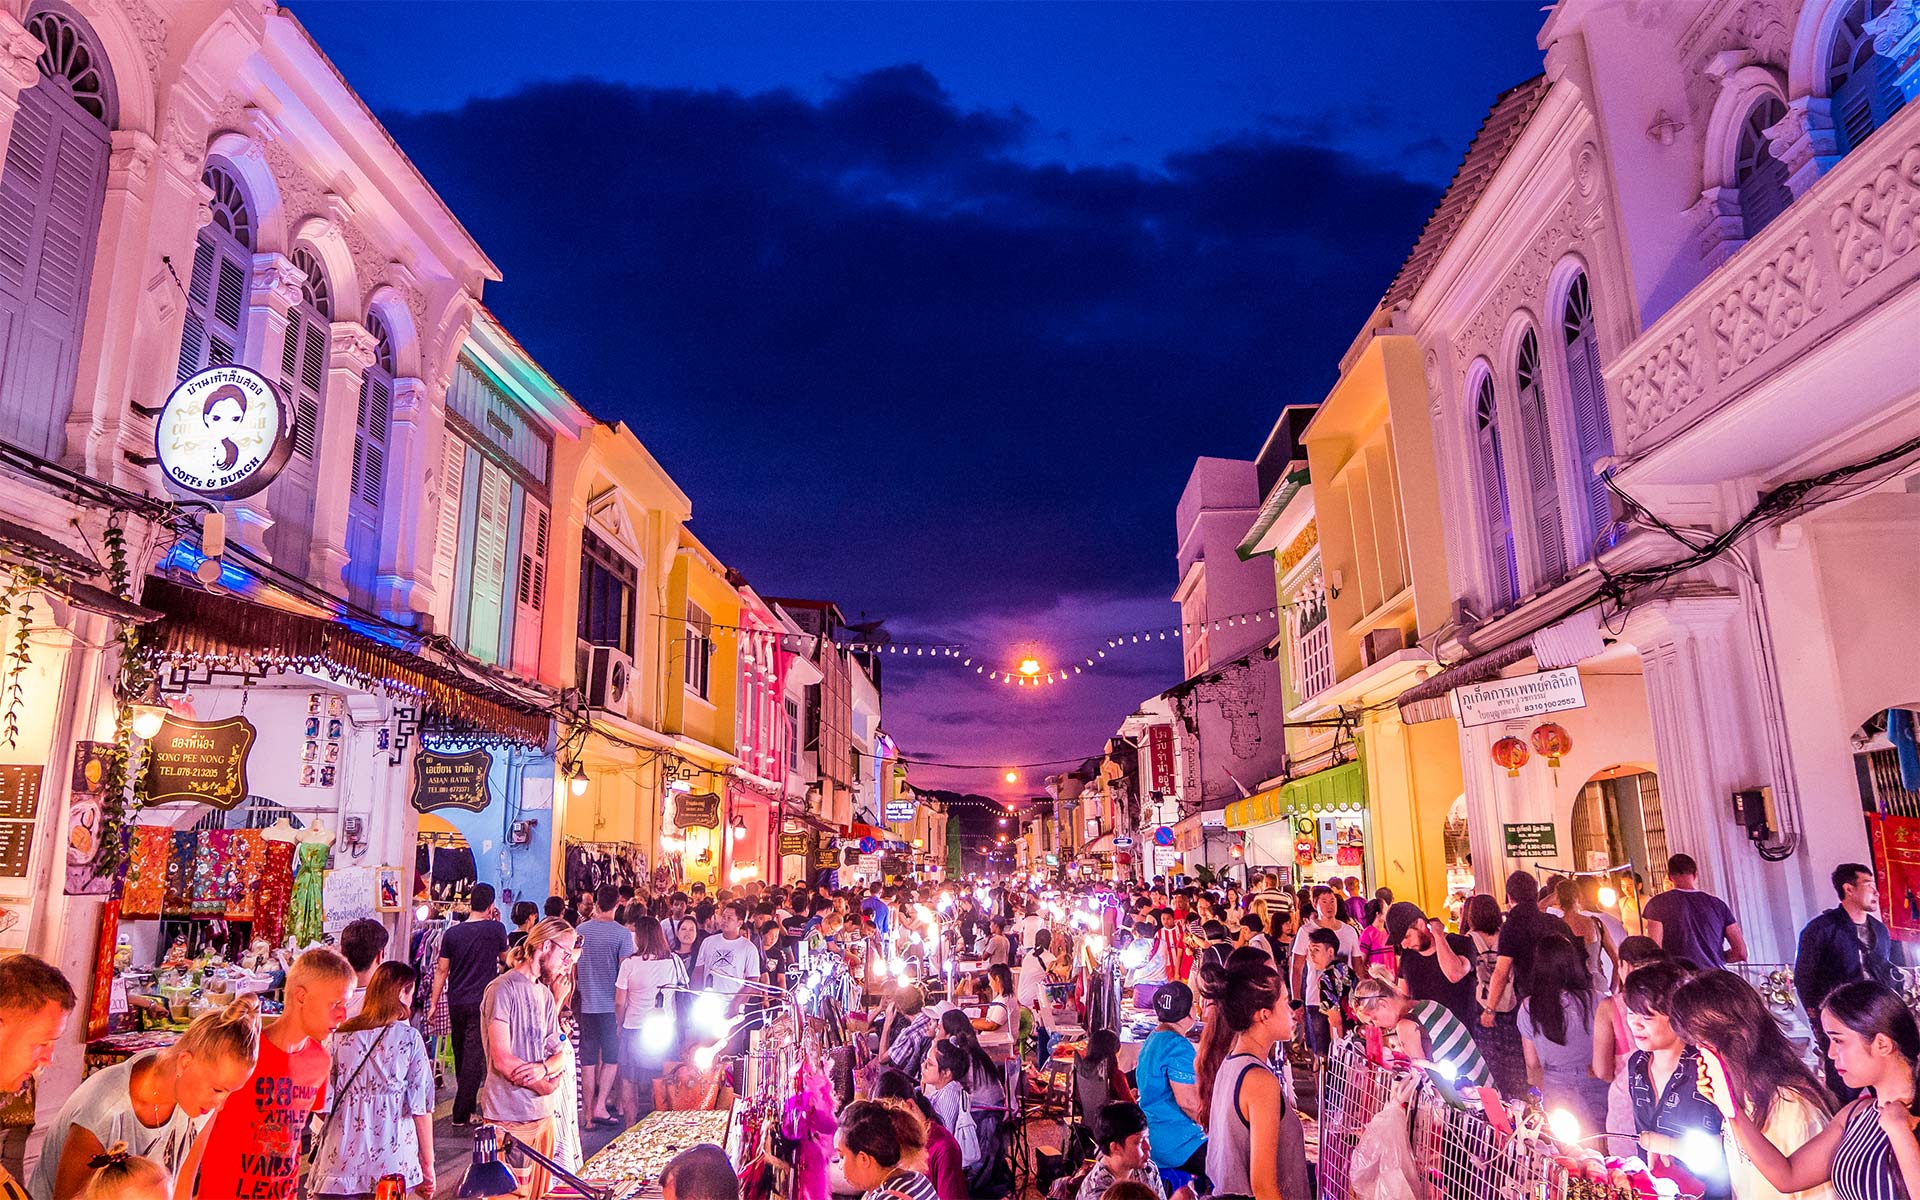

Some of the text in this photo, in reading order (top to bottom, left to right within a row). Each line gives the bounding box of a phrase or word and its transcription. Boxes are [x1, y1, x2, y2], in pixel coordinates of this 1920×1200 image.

[220, 457, 260, 486] BURGH
[157, 753, 225, 764] SONG PEE NONG
[256, 1077, 292, 1106] 98
